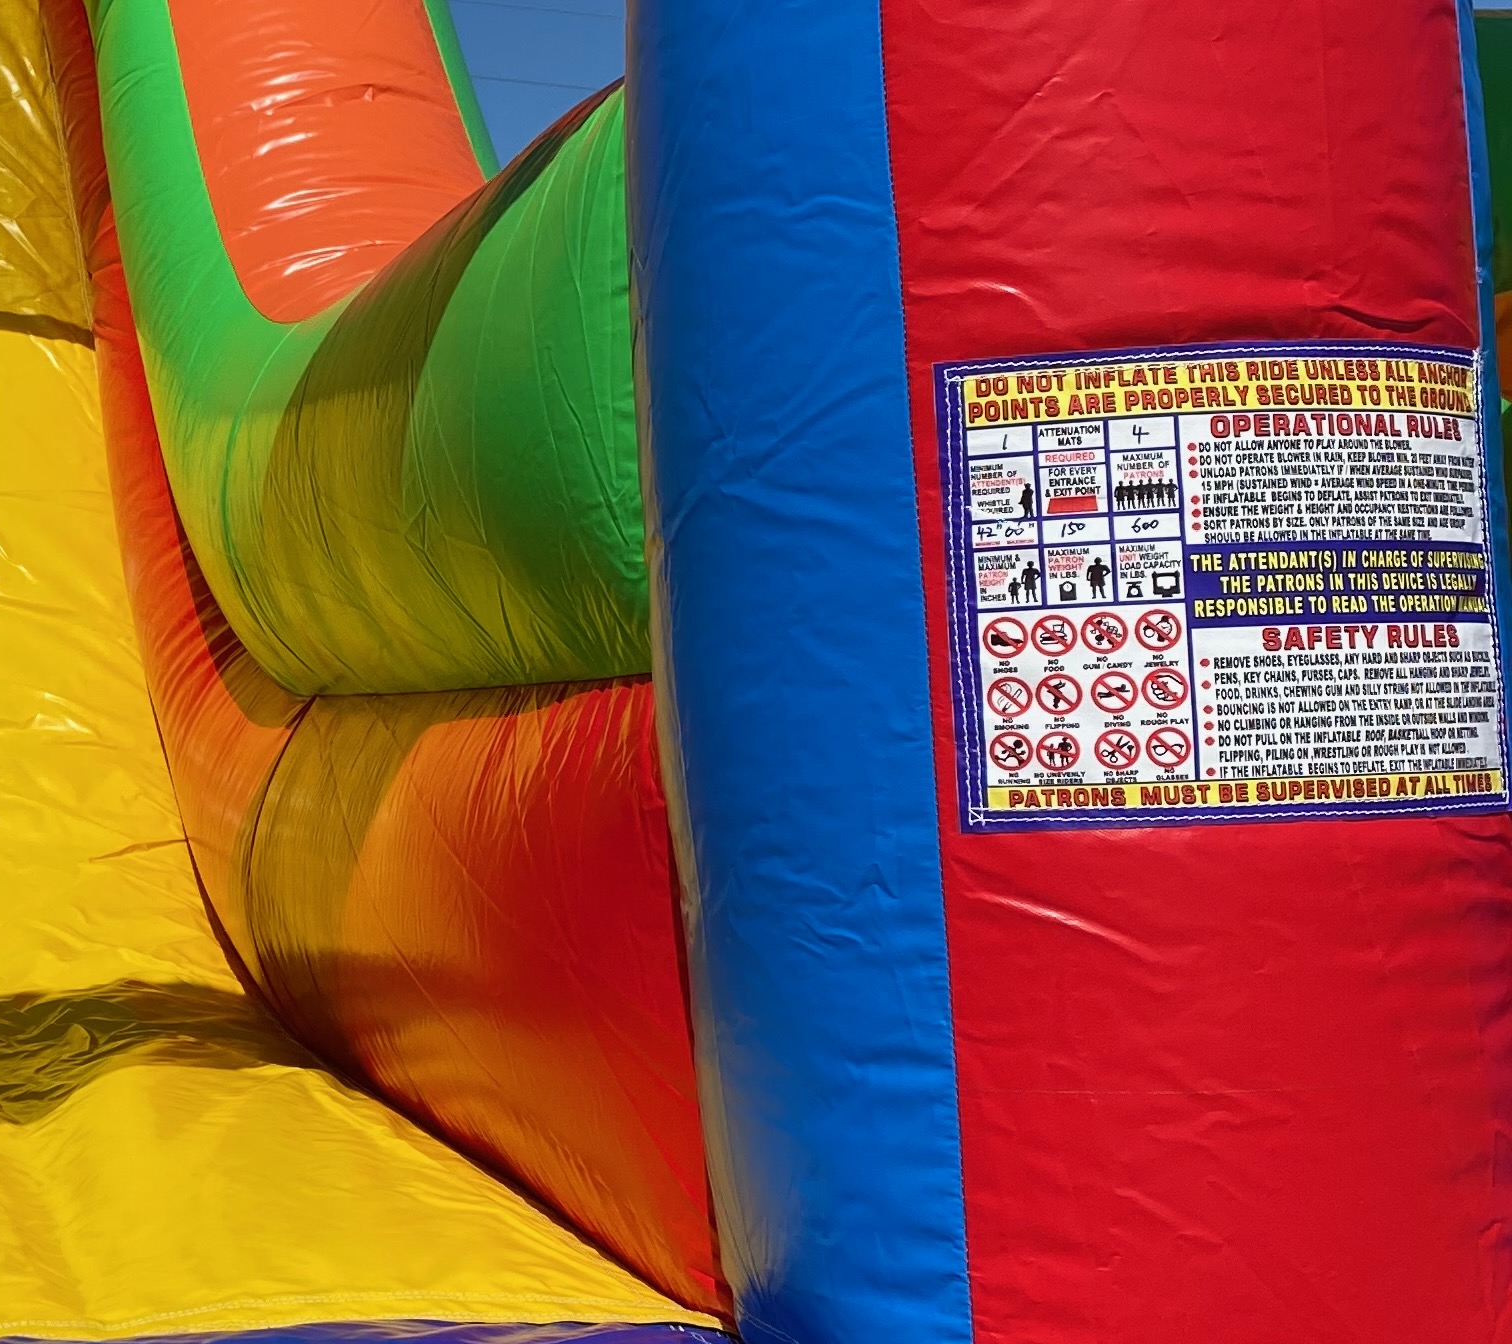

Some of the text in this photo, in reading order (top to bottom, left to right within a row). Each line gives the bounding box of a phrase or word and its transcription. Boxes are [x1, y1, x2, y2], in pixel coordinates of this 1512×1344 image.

[976, 359, 1468, 397] DO NOT INFLATE THIS RIDE UNLESS ALL ANCHOR
[968, 396, 1060, 423] POINTS
[1068, 392, 1116, 416] ARE
[1124, 385, 1249, 411] PROPERLY
[1256, 384, 1353, 405] SECURED
[1357, 385, 1381, 405] TO
[1385, 385, 1417, 407] THE
[1038, 425, 1100, 437] ATTENUATION
[1132, 424, 1150, 444] 4
[1210, 413, 1462, 441] OPERATIONAL RULES
[1058, 436, 1082, 446] MATS
[1199, 439, 1335, 453] DO NOT ALLOW ANYONE TO PLAY
[1045, 452, 1096, 463] REQUIRED
[1122, 452, 1163, 461] MAXIMUM
[1199, 452, 1311, 466] DO NOT OPERATE BLOWER
[1048, 466, 1097, 476] FOR EVERY
[1117, 461, 1170, 470] NUMBER OF
[1200, 465, 1335, 478] UNLOAD PATRONS IMMEDIATELY
[1049, 476, 1096, 487] ENTRANCE
[1124, 470, 1165, 479] PATRONS
[1054, 487, 1073, 496] EXIT
[1075, 486, 1101, 495] POINT
[1201, 478, 1288, 492] 15 MPH (SUSTAINED
[1202, 491, 1267, 504] IF INFLATABLE
[1202, 504, 1295, 517] ENSURE THE WEIGHT
[1061, 521, 1086, 538] 150
[1131, 517, 1159, 533] 600
[1203, 519, 1227, 530] SORT
[1230, 518, 1271, 529] PATRONS
[1273, 517, 1284, 527] BY
[1204, 530, 1298, 543] SHOULD BE ALLOWED
[1047, 548, 1090, 556] MAXIMUM
[1119, 544, 1156, 553] MAXIMUM
[1048, 556, 1085, 565] PATRON
[1139, 552, 1169, 561] WEIGHT
[1190, 553, 1223, 572] THE
[1229, 550, 1337, 572] ATTENDANT(S)
[1342, 550, 1356, 567] IN
[1362, 550, 1408, 568] CHARGE
[1410, 551, 1424, 568] OF
[1119, 560, 1182, 571] LOAD CAPACITY
[1220, 576, 1251, 593] THE
[1257, 573, 1324, 592] PATRONS
[1329, 573, 1344, 590] IN
[1348, 573, 1378, 590] THIS
[1382, 573, 1425, 590] DEVICE
[1426, 573, 1437, 590] IS
[1194, 596, 1303, 617] RESPONSIBLE
[1308, 596, 1327, 613] TO
[1332, 595, 1368, 613] READ
[1371, 595, 1397, 612] THE
[1399, 594, 1457, 613] OPERATION
[1262, 624, 1460, 651] SAFETY RULES
[1213, 653, 1343, 669] REMOVE SHOES, EYEGLASSES,
[1214, 669, 1336, 686] PENS, KEY CHAINS, PURSES,
[1215, 684, 1343, 701] FOOD, DRINKS, CHEWING GUM
[1217, 700, 1337, 716] BOUNCING IS NOT ALLOWED
[1218, 716, 1333, 732] NO CLIMBING OR HANGING
[1218, 732, 1311, 747] DO NOT PULL ON THE
[1219, 747, 1309, 764] FLIPPING, PILING ON
[1219, 763, 1303, 778] IF THE INFLATABLE
[1008, 773, 1493, 807] PATRONS MUST BE SUPERVISED AT ALL TIMES
